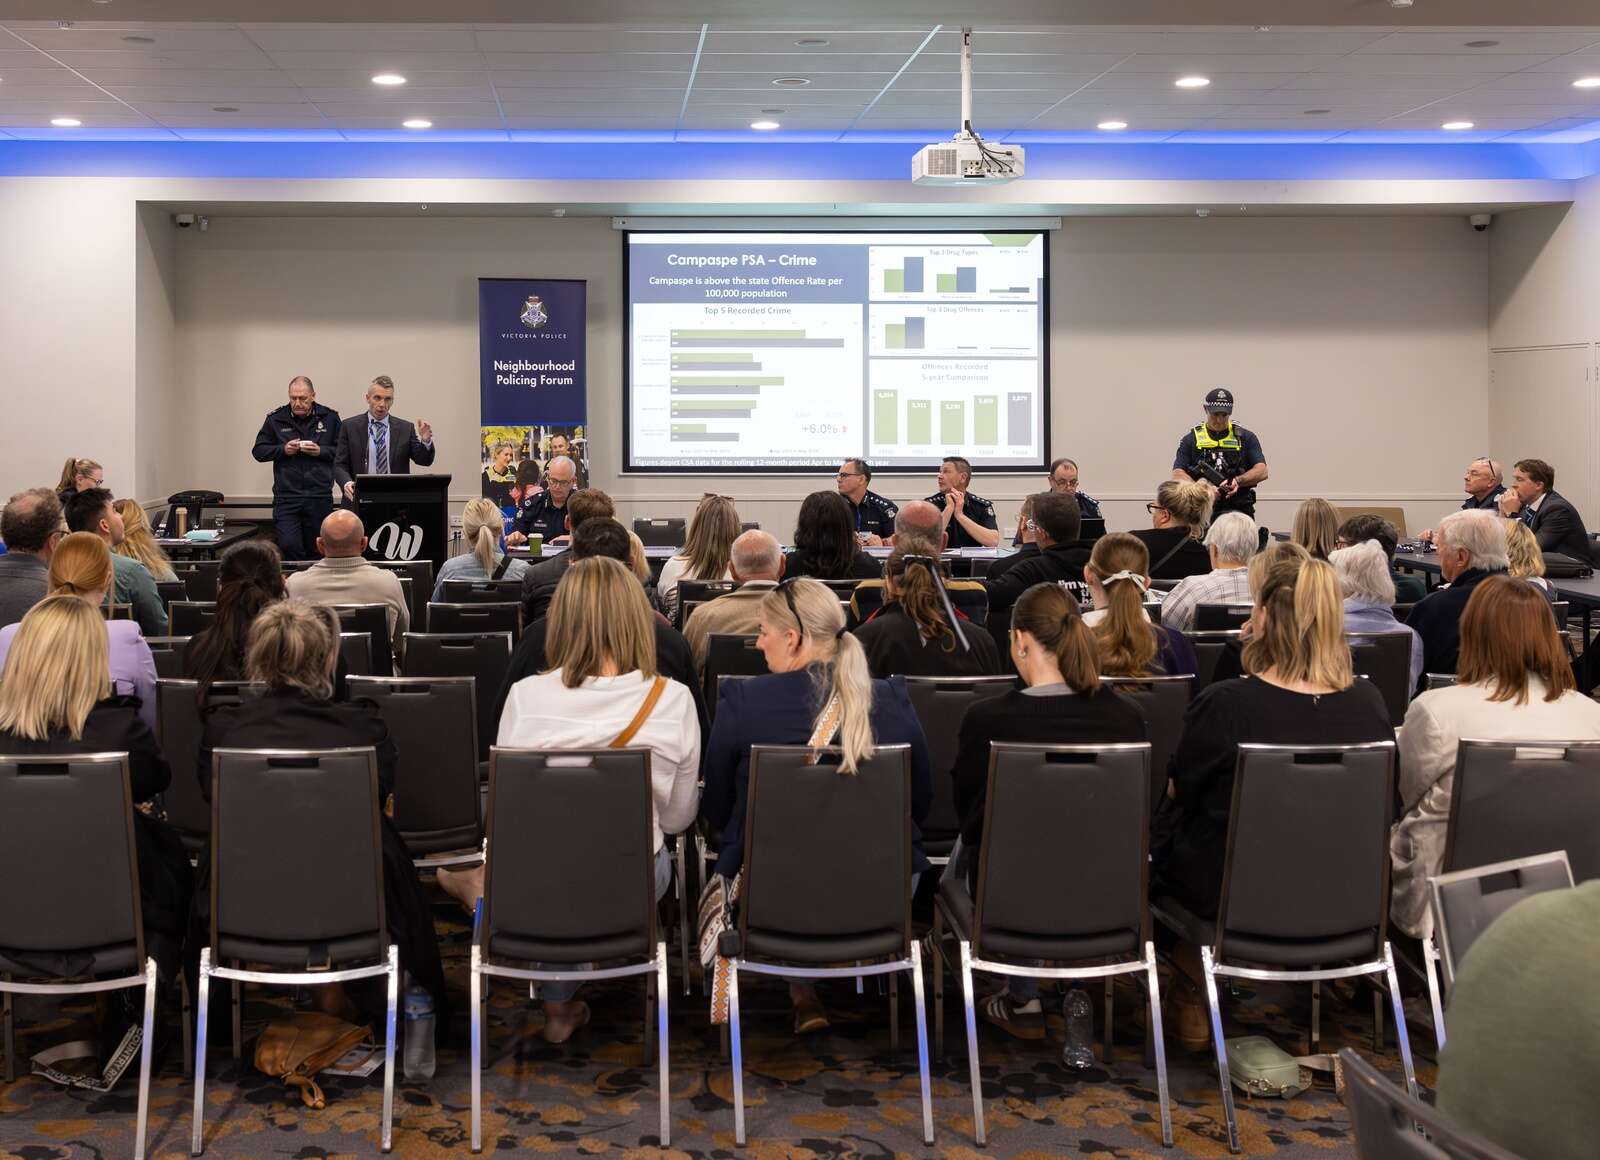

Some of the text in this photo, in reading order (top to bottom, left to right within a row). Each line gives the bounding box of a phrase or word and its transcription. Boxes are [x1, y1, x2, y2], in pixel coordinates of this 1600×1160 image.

[667, 254, 738, 267] Campaspe
[742, 254, 766, 266] PSA
[779, 254, 817, 266] Crime
[649, 276, 843, 287] Campaspe is above the state Offence Rate per
[705, 289, 787, 299] 100,000 population
[704, 307, 719, 316] Top
[728, 306, 766, 314] Recorded
[768, 306, 791, 314] Crime
[494, 359, 575, 373] Neighbourhood
[496, 373, 573, 387] Policing Forum
[802, 424, 838, 434] +6.0%
